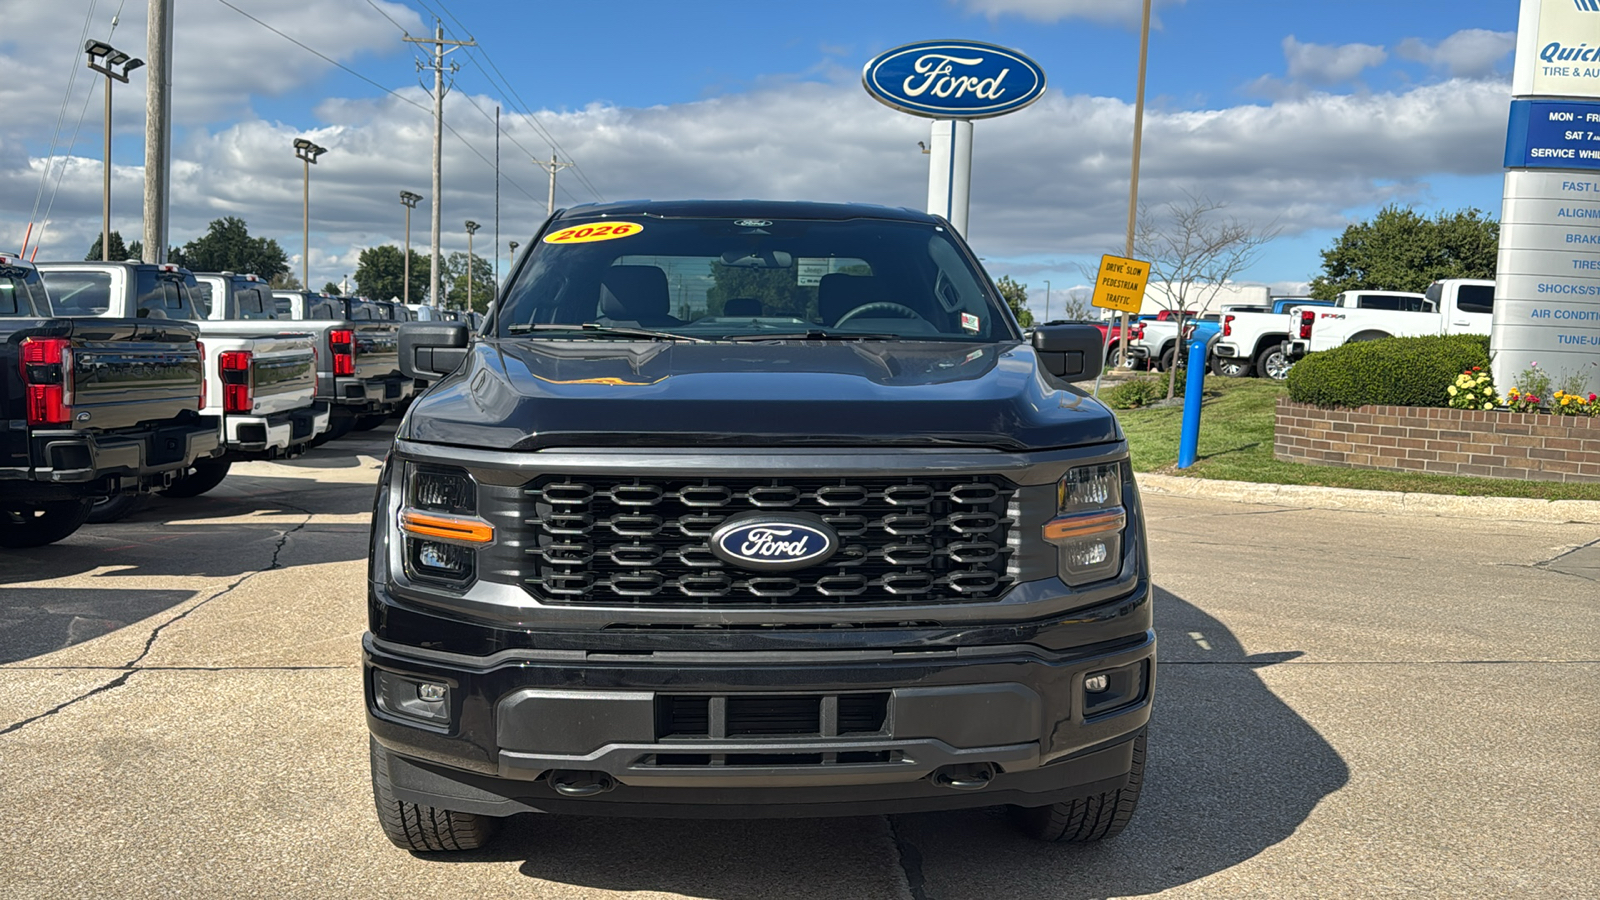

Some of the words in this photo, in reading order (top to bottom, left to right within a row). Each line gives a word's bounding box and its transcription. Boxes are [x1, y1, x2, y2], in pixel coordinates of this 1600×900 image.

[902, 53, 1010, 100] Ford
[1542, 66, 1570, 77] TIRE
[1572, 67, 1581, 77] &
[1549, 112, 1574, 121] MON
[1565, 131, 1584, 140] SAT
[1530, 148, 1575, 159] SERVICE
[1562, 181, 1591, 192] FAST
[553, 225, 632, 242] 2026
[1105, 262, 1124, 274] DRIVE
[1126, 265, 1142, 276] SLOW
[1102, 277, 1139, 291] PEDESTRIAN
[1105, 293, 1131, 305] TRAFFIC
[1531, 309, 1551, 319] AIR
[741, 528, 809, 556] Ford
